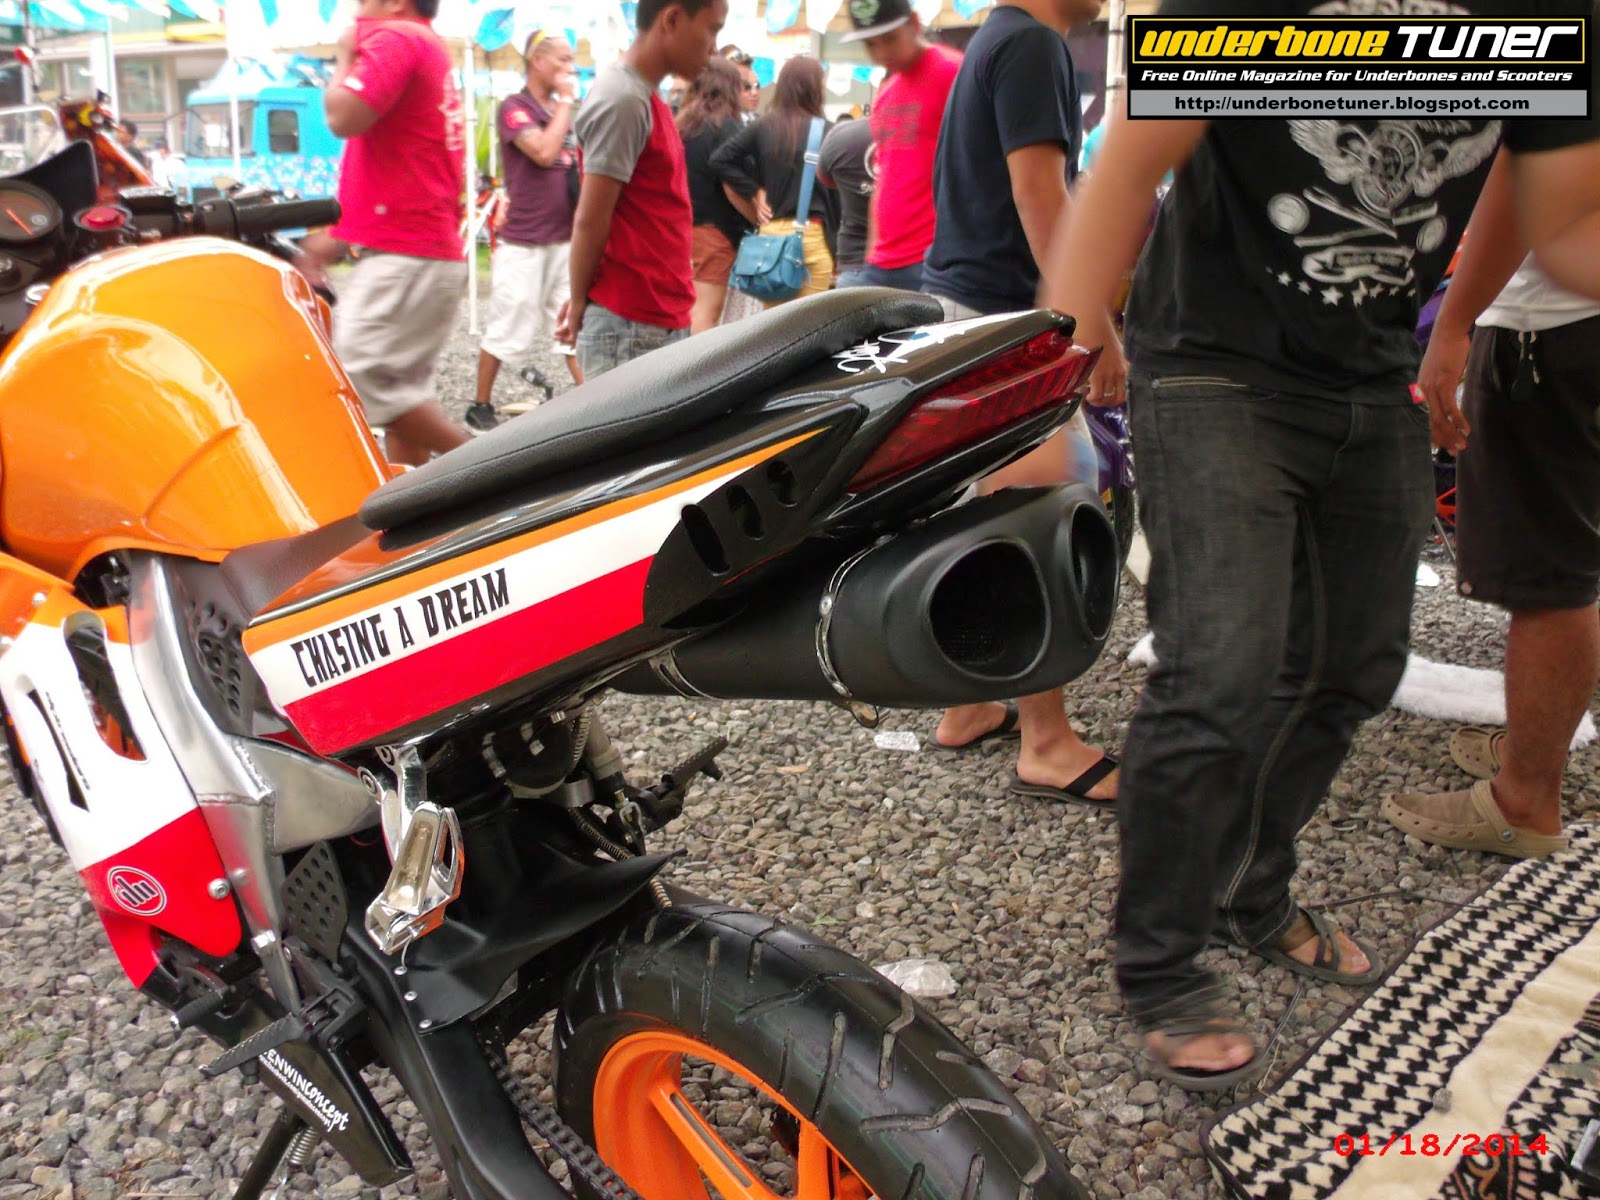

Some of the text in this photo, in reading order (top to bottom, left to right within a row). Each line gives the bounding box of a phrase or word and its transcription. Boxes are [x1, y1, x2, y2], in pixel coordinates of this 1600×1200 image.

[290, 567, 510, 688] CHASING A DREAM
